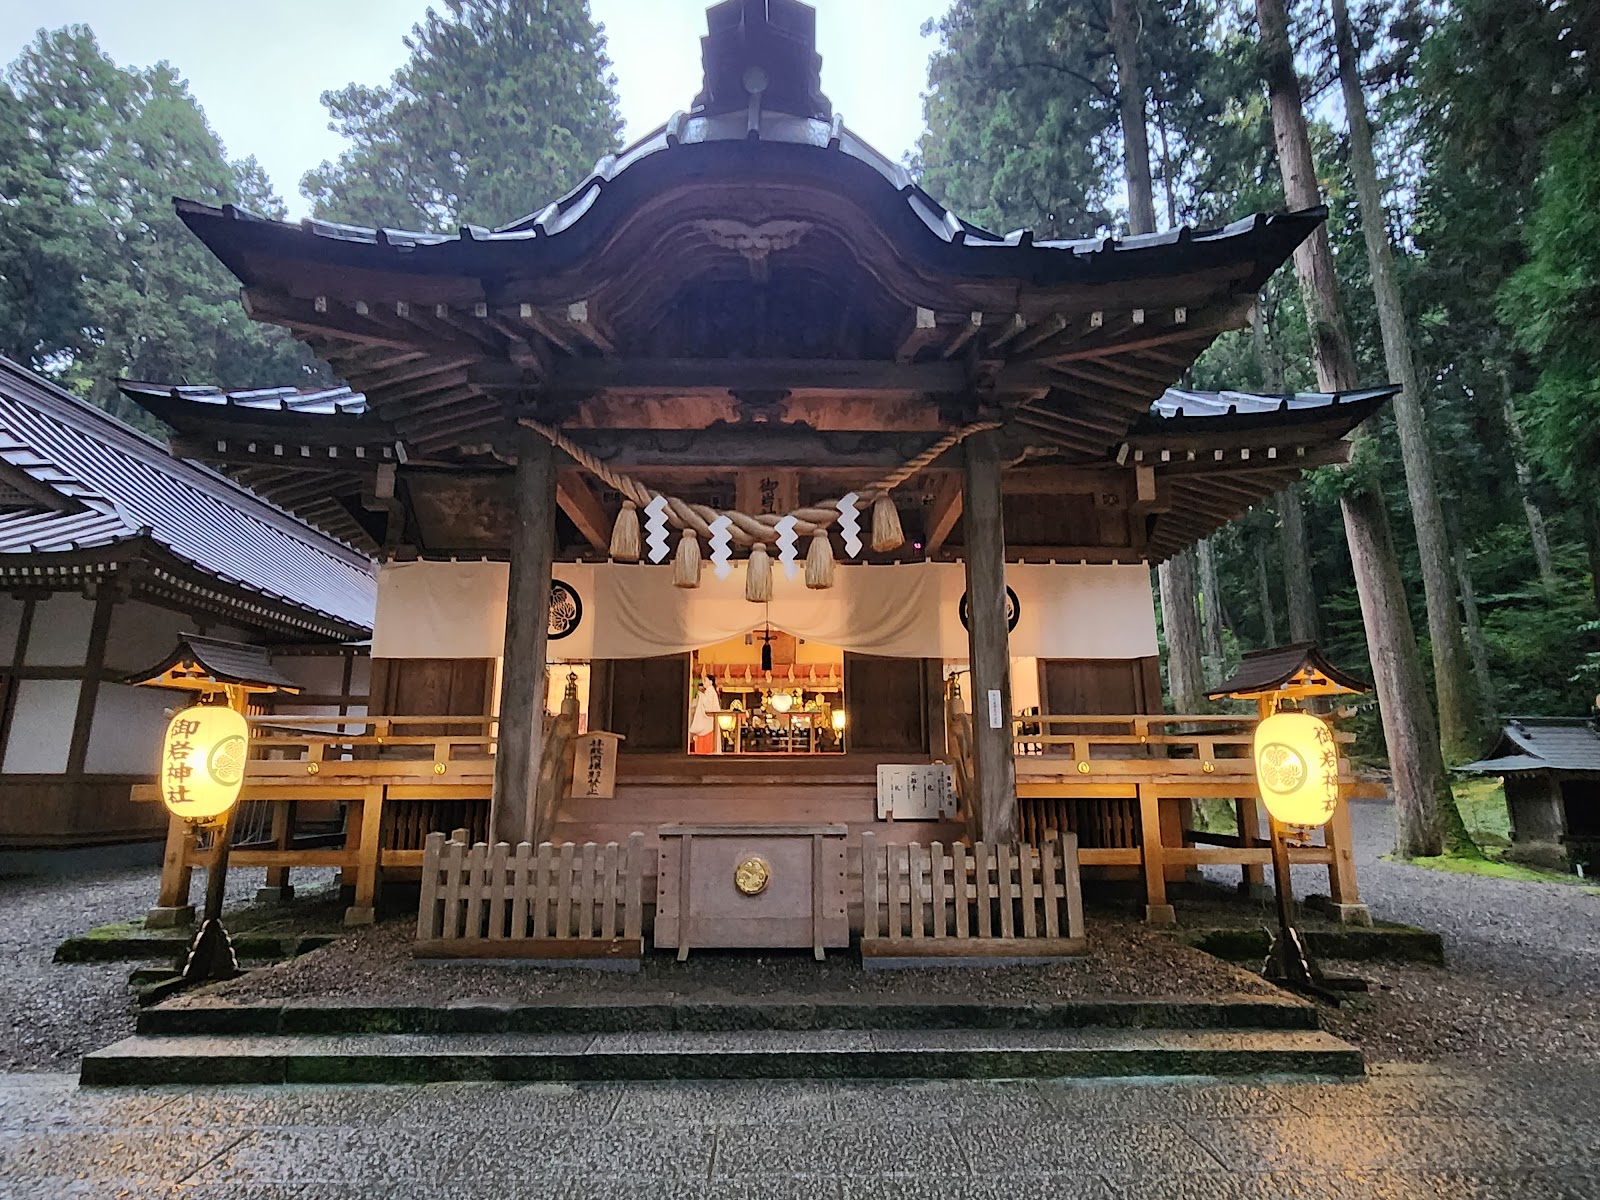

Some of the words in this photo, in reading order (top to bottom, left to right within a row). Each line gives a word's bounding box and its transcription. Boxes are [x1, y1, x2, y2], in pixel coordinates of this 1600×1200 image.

[167, 719, 201, 804] 御岩神社
[586, 738, 604, 796] 拝殿内撮影禁止
